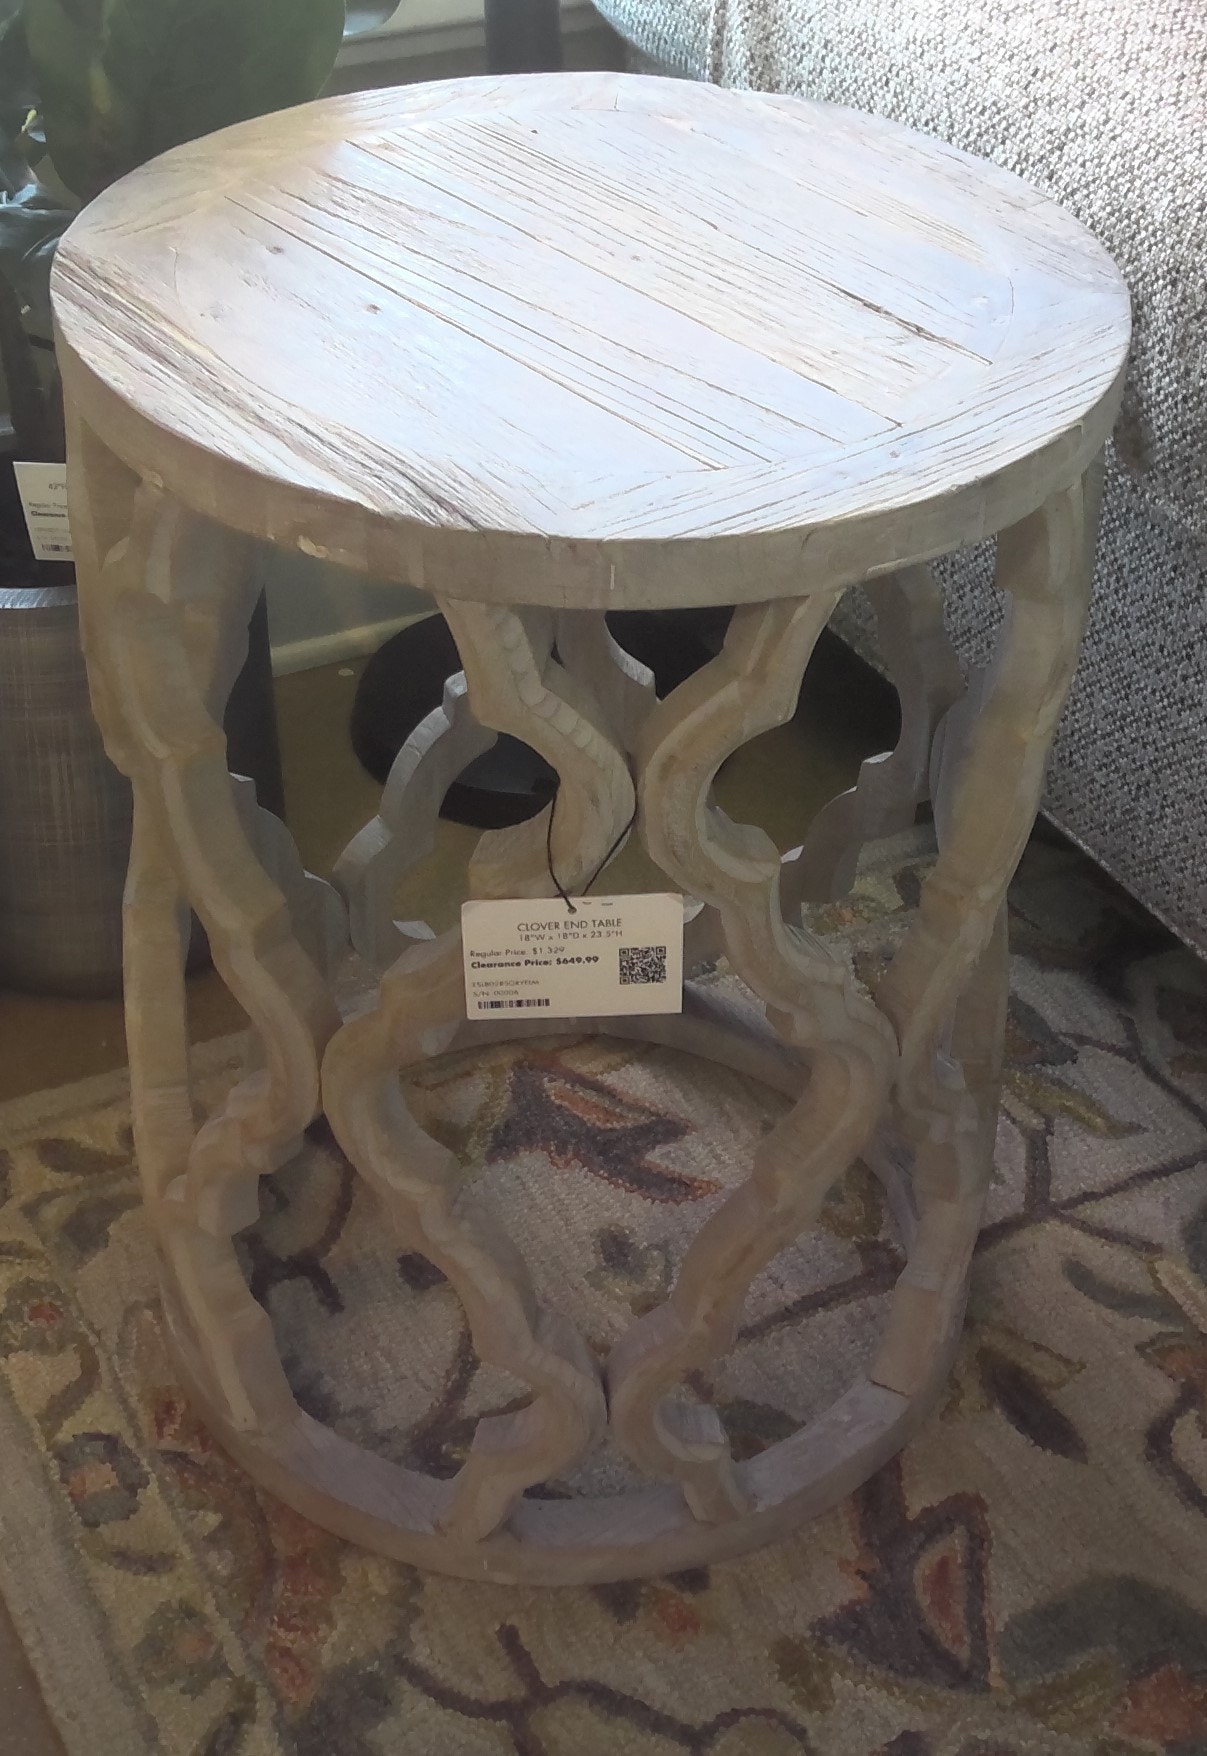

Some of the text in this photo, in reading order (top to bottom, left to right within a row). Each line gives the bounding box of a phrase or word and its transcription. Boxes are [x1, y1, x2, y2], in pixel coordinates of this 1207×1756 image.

[516, 918, 622, 932] CLOVER END TABLE
[470, 950, 502, 959] Regular
[471, 956, 599, 969] Clearance Price: $649.99
